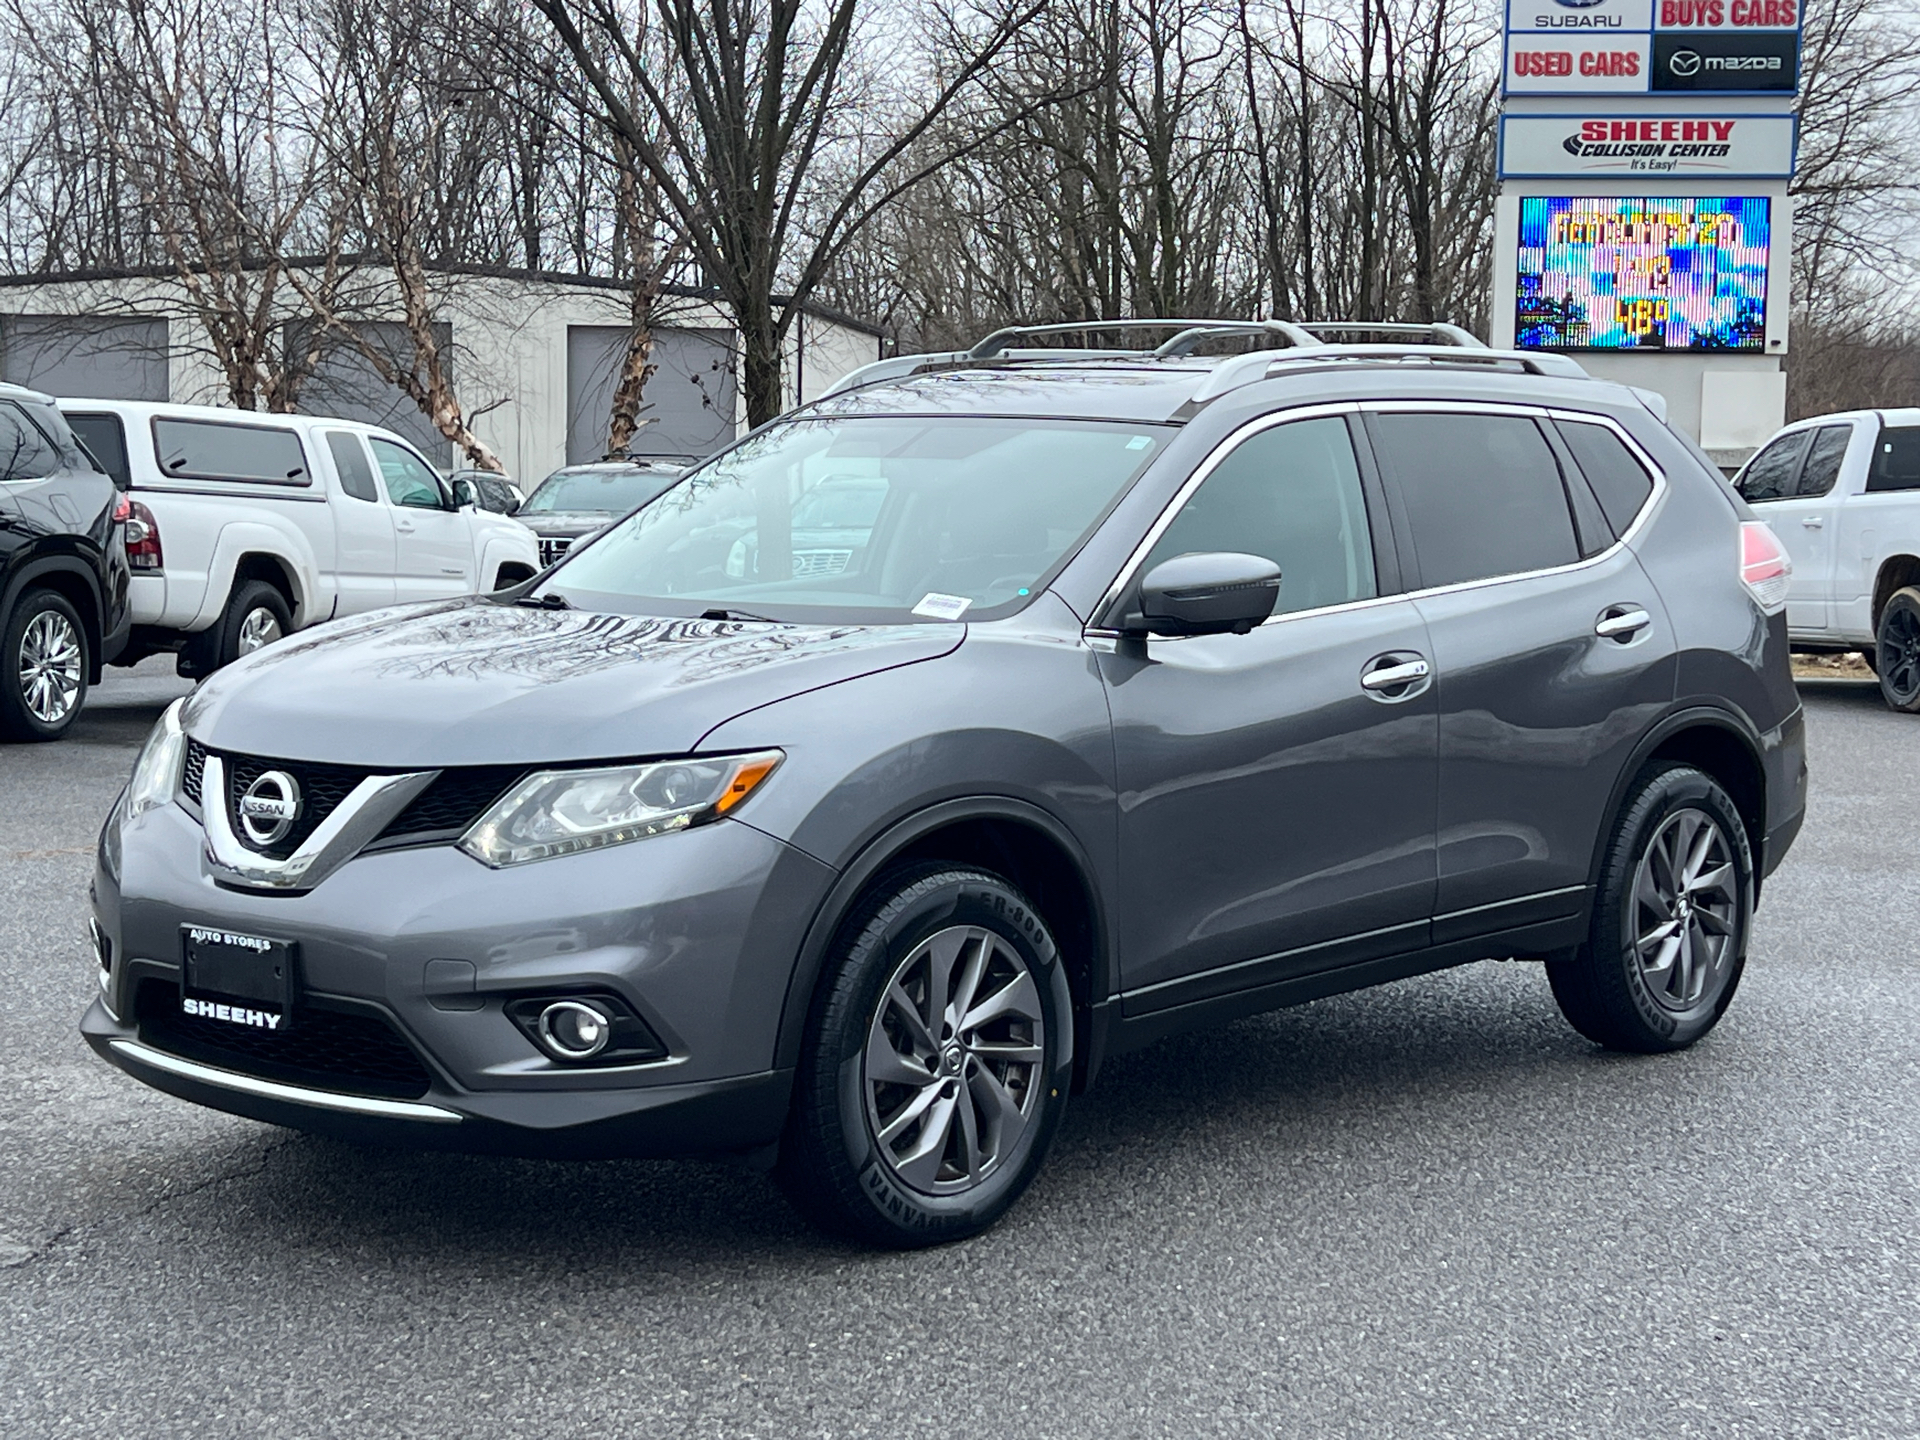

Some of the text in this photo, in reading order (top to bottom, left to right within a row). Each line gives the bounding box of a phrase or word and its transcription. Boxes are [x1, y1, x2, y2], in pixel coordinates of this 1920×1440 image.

[1535, 15, 1622, 27] SUBARU
[1661, 0, 1796, 26] BUYS CARS
[1514, 51, 1640, 76] USED CARS
[1581, 121, 1736, 141] SHEEHY
[1581, 144, 1731, 157] COLLISION CENTER
[1630, 159, 1677, 172] It's Easy!
[190, 929, 271, 951] AUTO STORES
[183, 998, 281, 1029] SHEEHY
